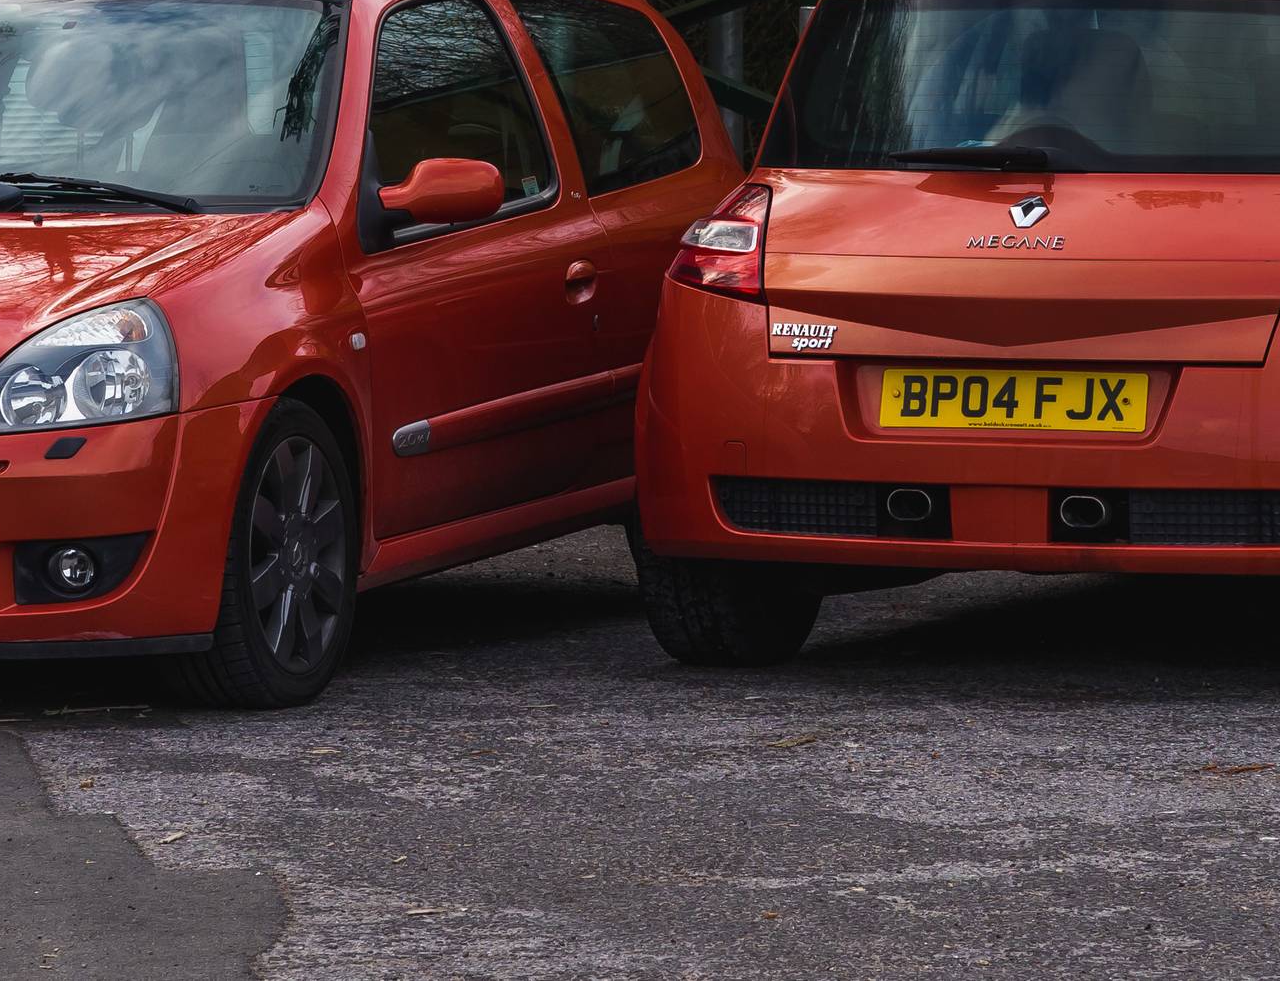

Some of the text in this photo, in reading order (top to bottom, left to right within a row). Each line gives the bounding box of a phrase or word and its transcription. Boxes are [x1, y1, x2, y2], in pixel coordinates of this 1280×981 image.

[965, 234, 1066, 251] MEGANE
[771, 323, 838, 337] RENAULT
[791, 336, 833, 351] sport
[900, 374, 1127, 422] BP04 FJX
